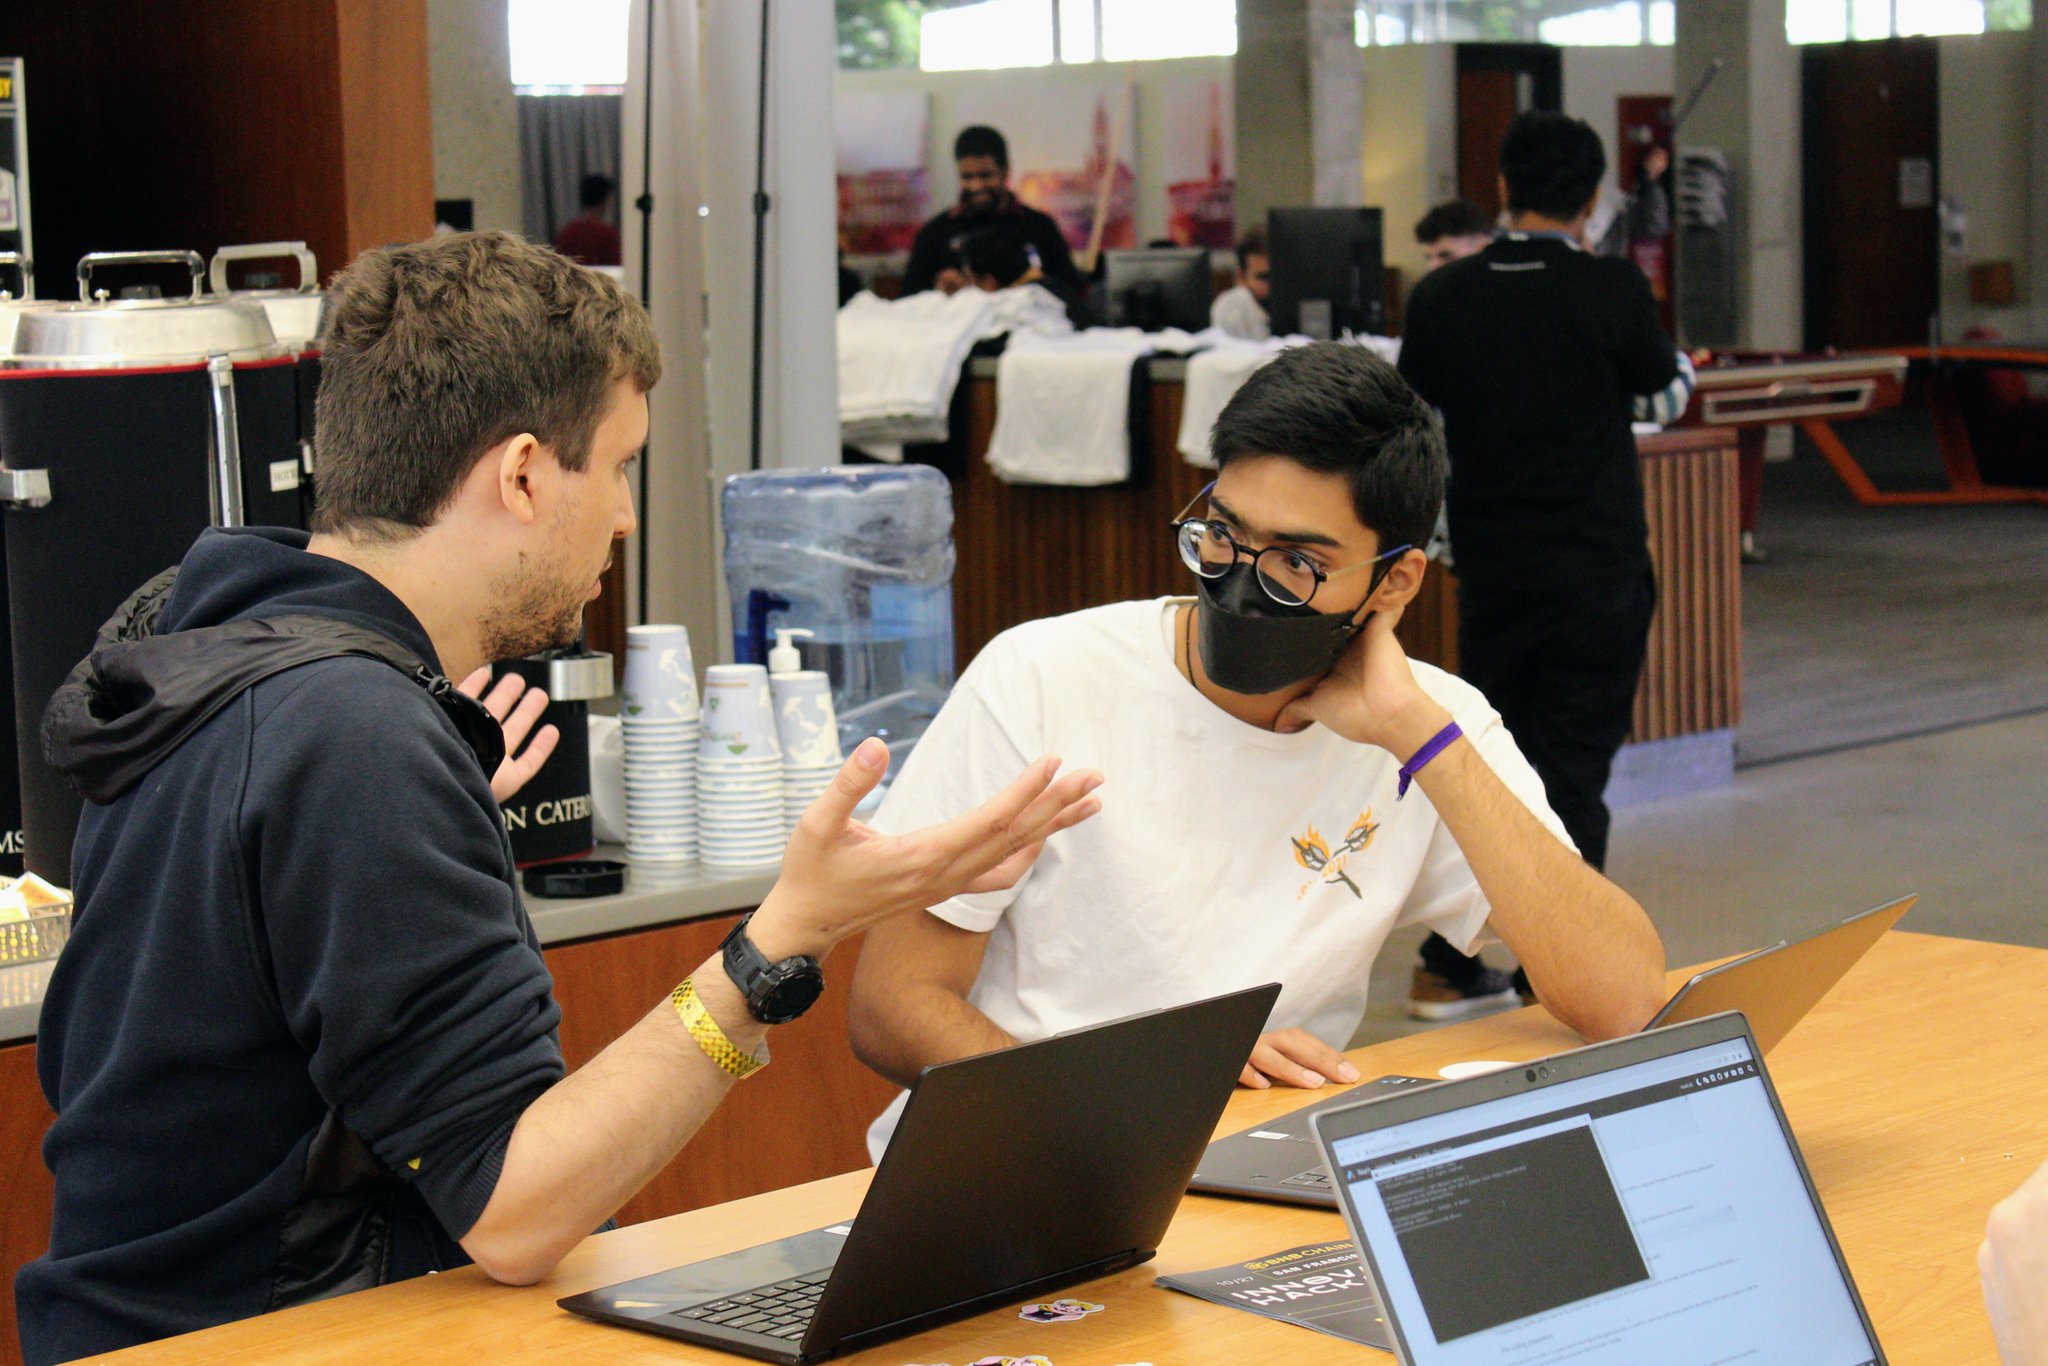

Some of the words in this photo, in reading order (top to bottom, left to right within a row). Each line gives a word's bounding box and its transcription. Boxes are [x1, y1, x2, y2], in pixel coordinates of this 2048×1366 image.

[1264, 1252, 1303, 1265] BNB
[1300, 1242, 1355, 1257] CHAIN
[1272, 1266, 1302, 1276] SAN
[1250, 1275, 1368, 1306] HACK
